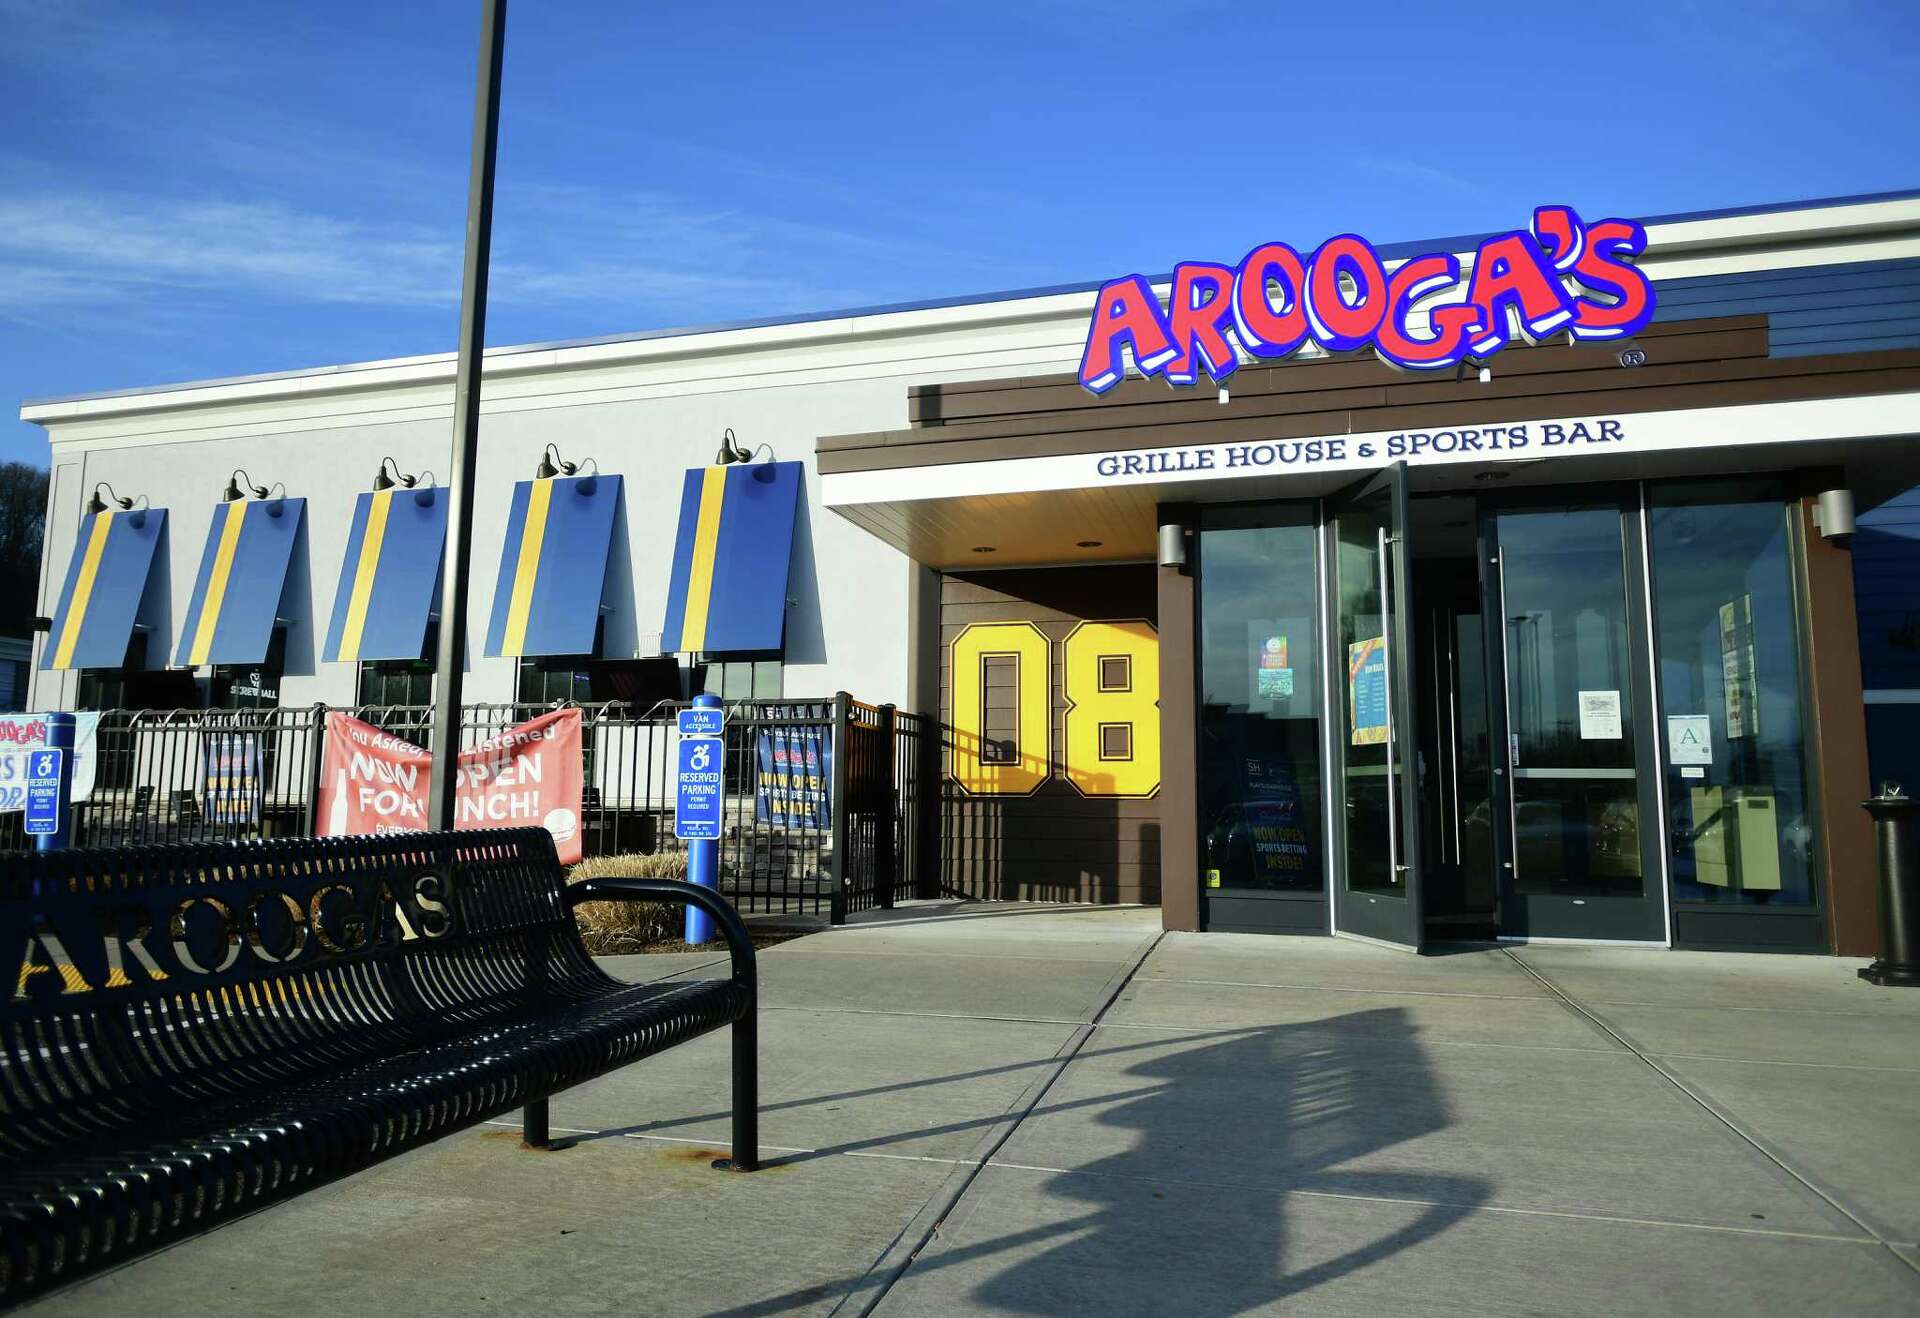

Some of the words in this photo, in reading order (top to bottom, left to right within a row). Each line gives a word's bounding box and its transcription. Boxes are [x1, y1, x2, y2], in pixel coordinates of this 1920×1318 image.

[1079, 205, 1656, 396] AROOGA'S
[1097, 450, 1216, 477] GRILLE
[1226, 440, 1347, 468] HOUSE
[1358, 443, 1376, 457] &
[1387, 425, 1529, 456] SPORTS
[1541, 420, 1625, 446] BAR
[230, 685, 278, 699] SCREWALL
[1680, 727, 1698, 745] A
[350, 751, 418, 793] NOW
[680, 772, 719, 783] RESERVED
[682, 784, 717, 795] PARKING
[454, 790, 540, 823] NCH!
[770, 799, 817, 816] NSIDE!
[13, 875, 451, 1000] AROOGAS
